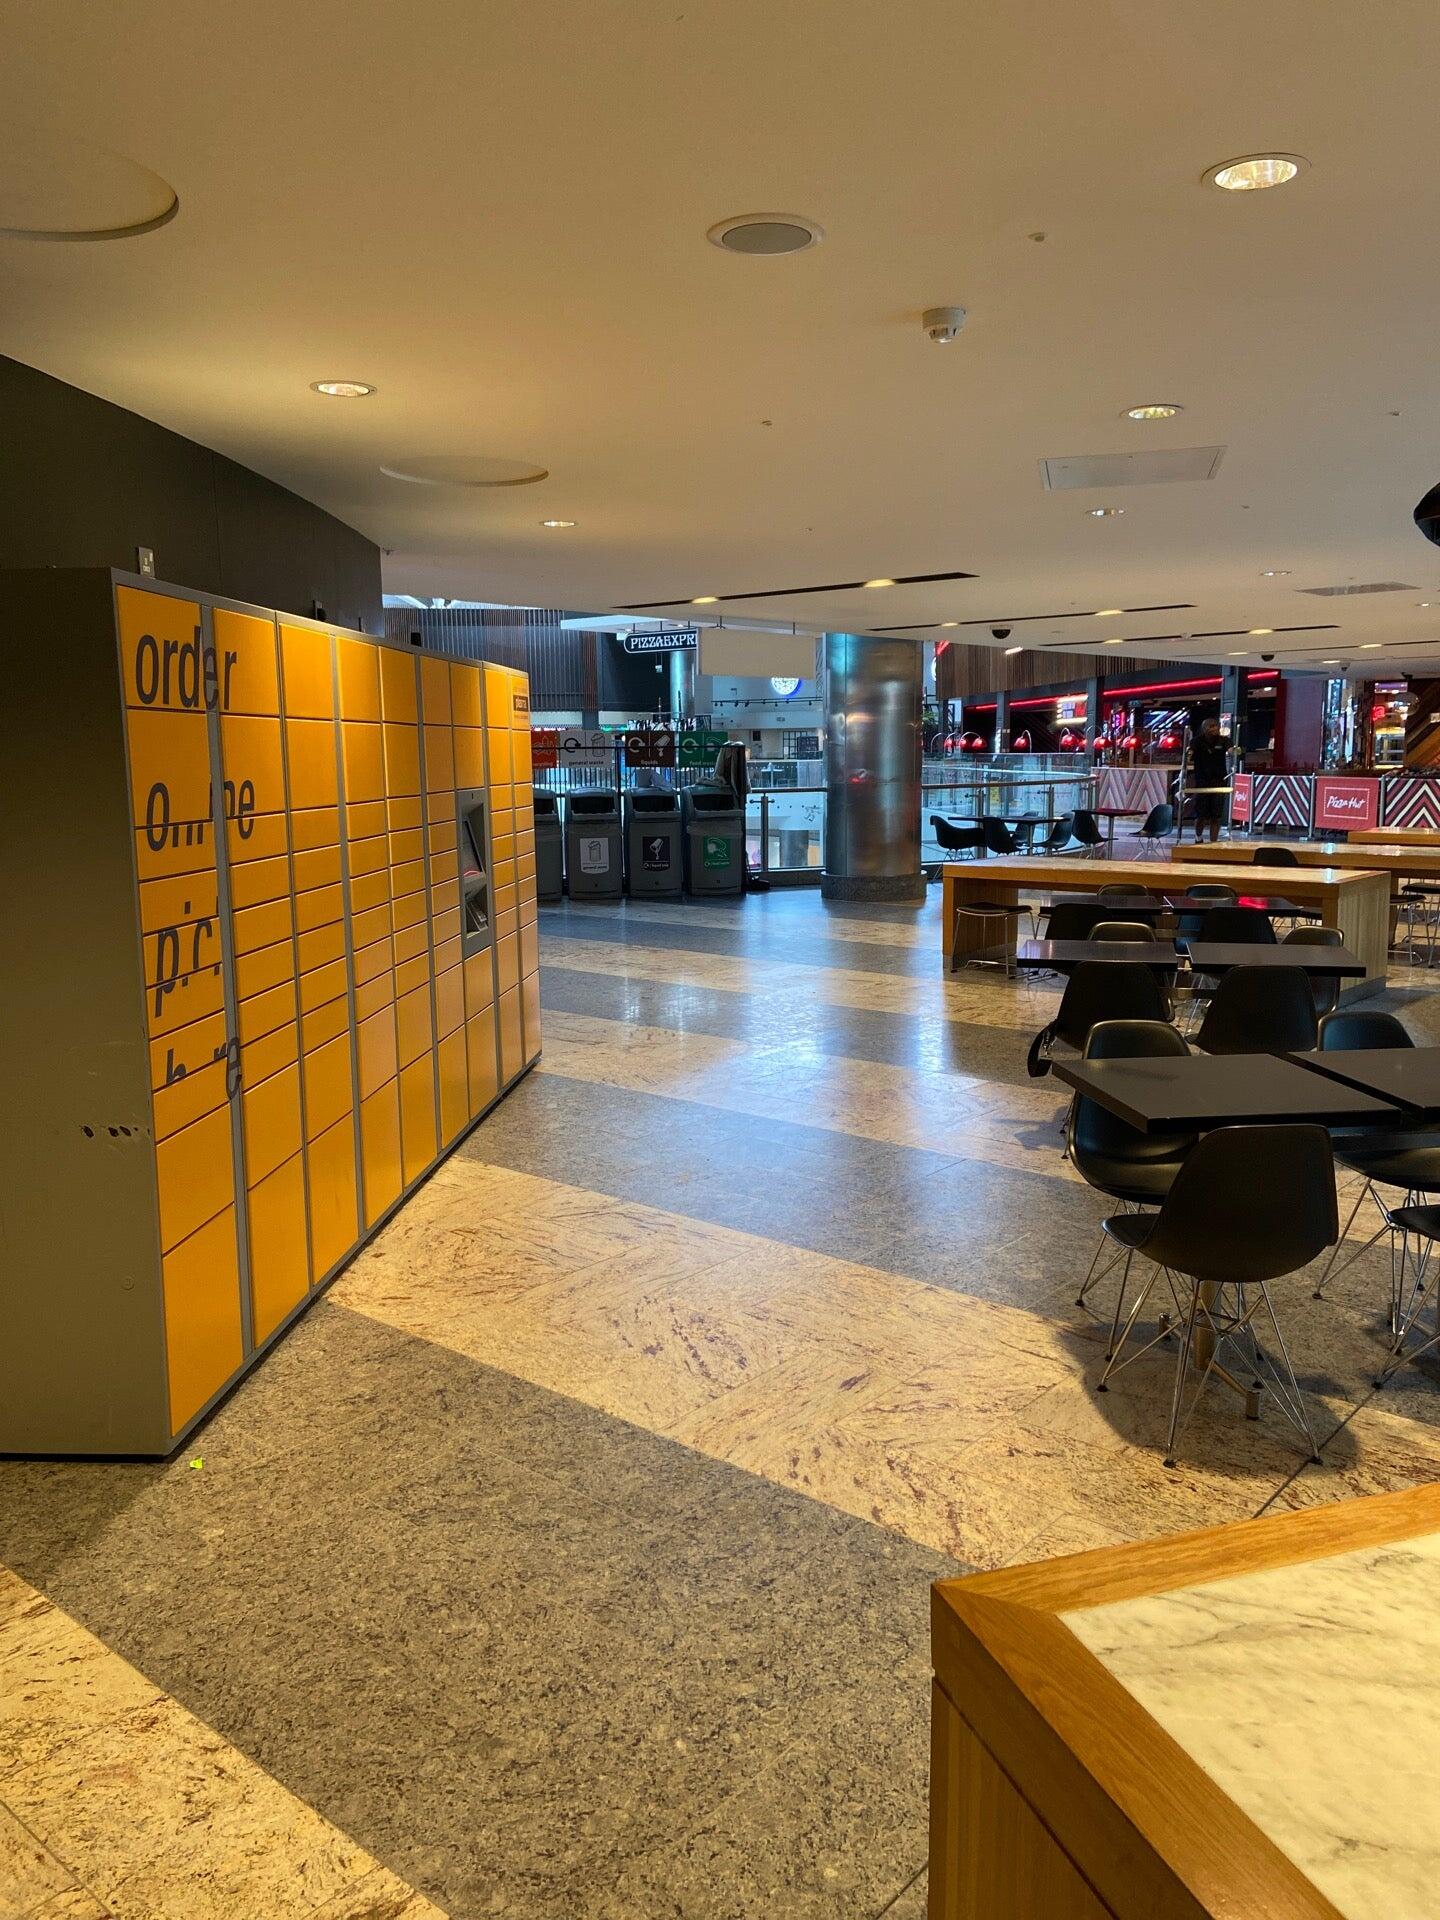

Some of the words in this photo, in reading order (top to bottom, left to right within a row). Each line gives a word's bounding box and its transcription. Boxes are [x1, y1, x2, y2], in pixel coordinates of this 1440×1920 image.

[631, 634, 697, 649] PIZZAEXPR
[136, 626, 237, 711] order
[1327, 796, 1348, 808] Pizza
[1349, 797, 1367, 809] Hut
